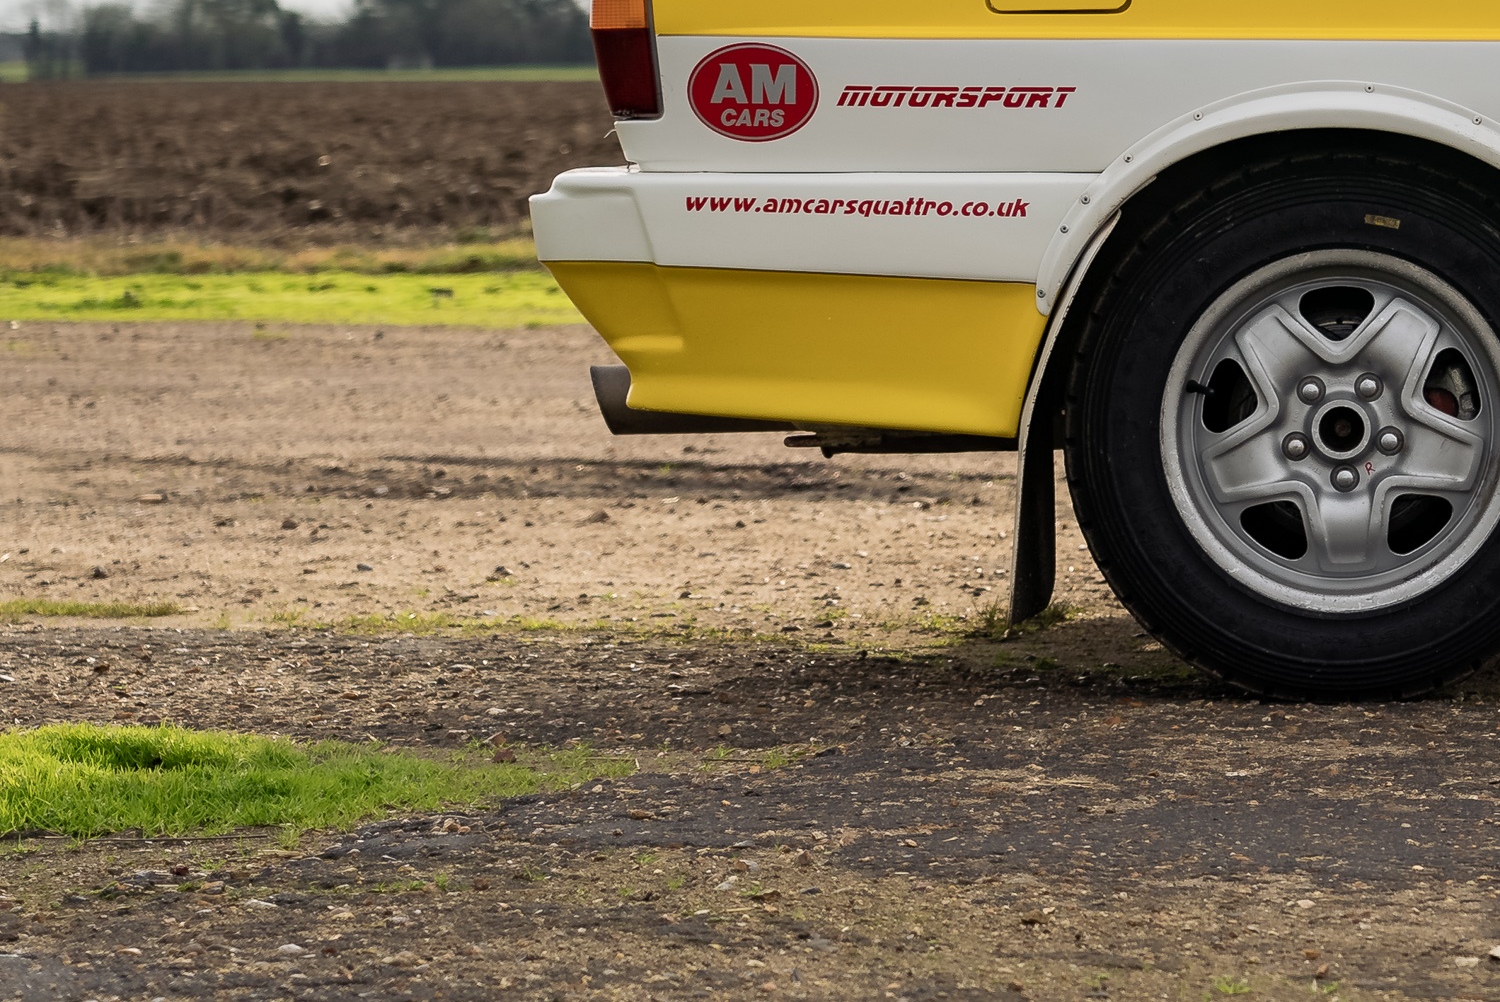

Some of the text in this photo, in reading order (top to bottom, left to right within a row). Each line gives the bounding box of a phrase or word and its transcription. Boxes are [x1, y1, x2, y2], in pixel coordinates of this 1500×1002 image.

[709, 62, 797, 105] AM
[836, 85, 1077, 110] MOTORSPORT
[720, 108, 785, 128] CARS
[685, 196, 1030, 218] www.amcarsquattro.co.uk
[1364, 462, 1376, 476] R
